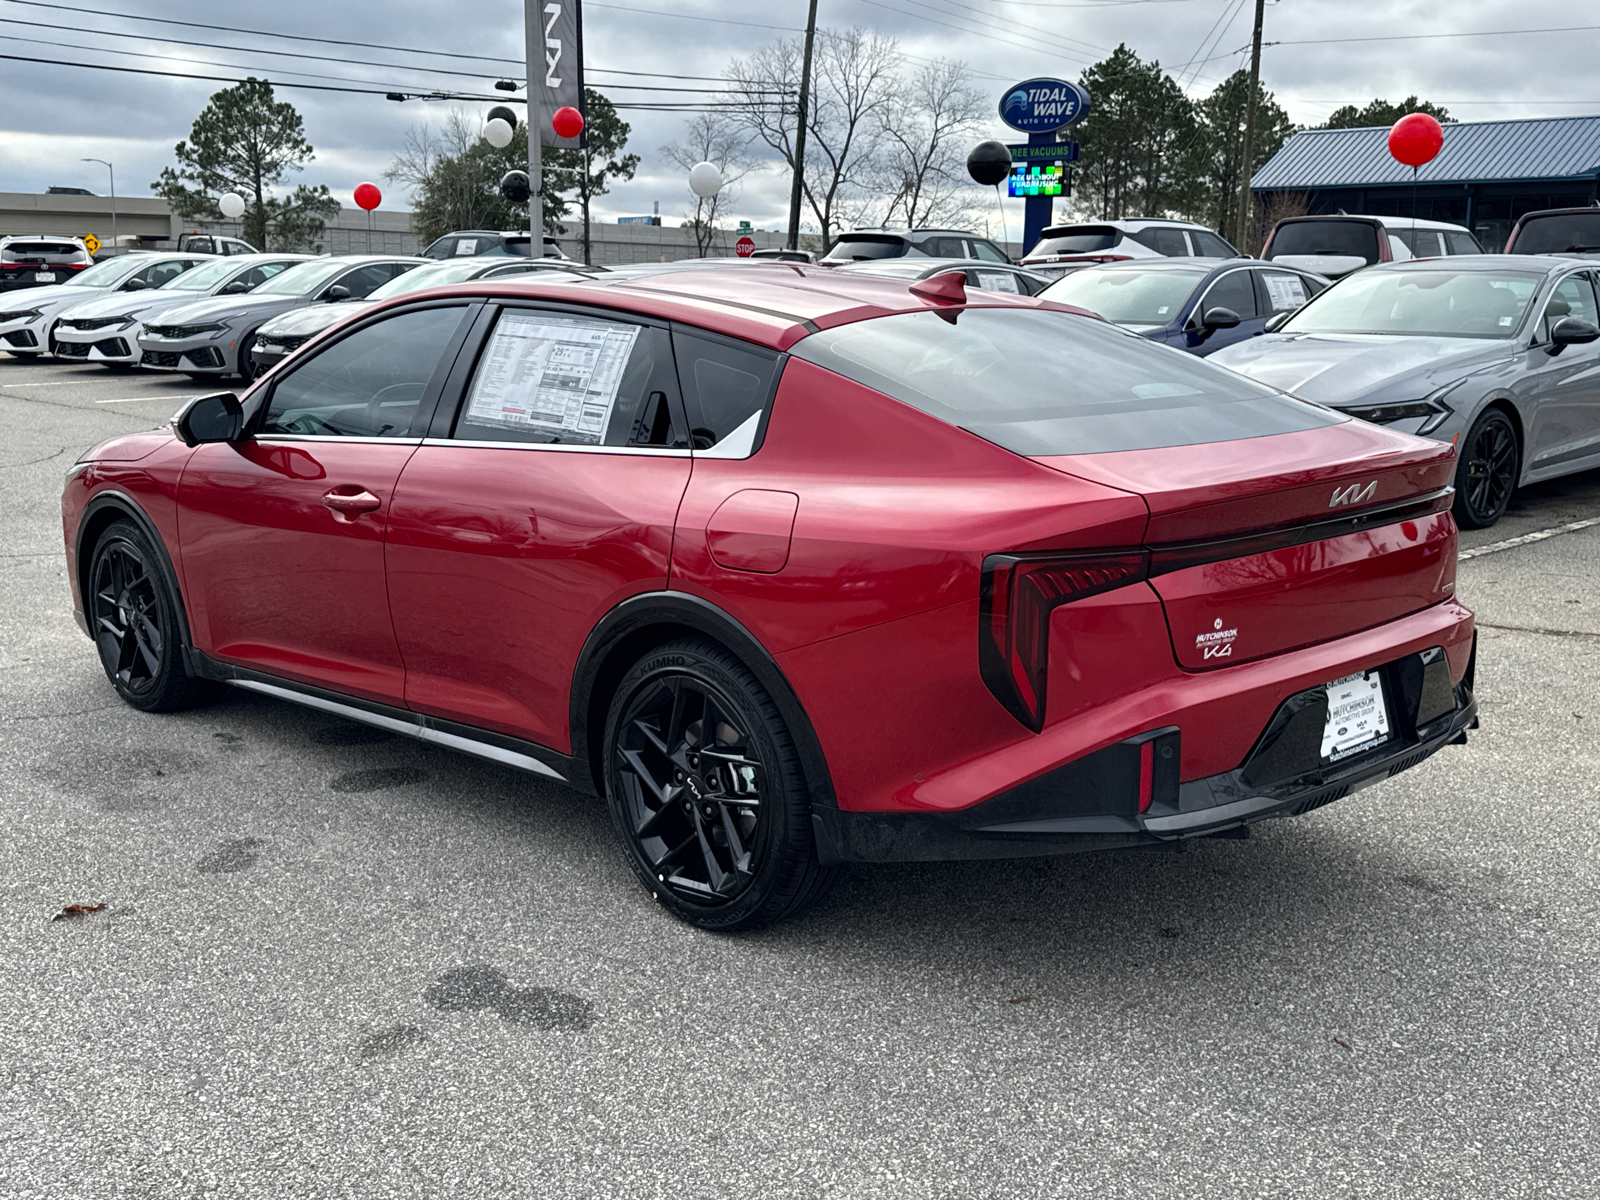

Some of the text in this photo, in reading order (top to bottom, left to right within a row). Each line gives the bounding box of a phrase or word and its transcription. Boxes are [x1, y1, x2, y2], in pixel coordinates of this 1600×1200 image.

[1028, 88, 1067, 102] TIDAL
[1033, 102, 1075, 116] WAVE
[1029, 145, 1069, 157] VACUUMS
[736, 243, 755, 254] STOP
[1328, 480, 1378, 508] KIA
[1195, 628, 1238, 643] HUTCHINSON
[1203, 643, 1232, 660] K4
[640, 655, 686, 676] KUMHO
[1332, 694, 1376, 719] HUTCHINSON
[1334, 711, 1361, 726] AUTOMOTIVE
[1361, 705, 1375, 717] GROUP
